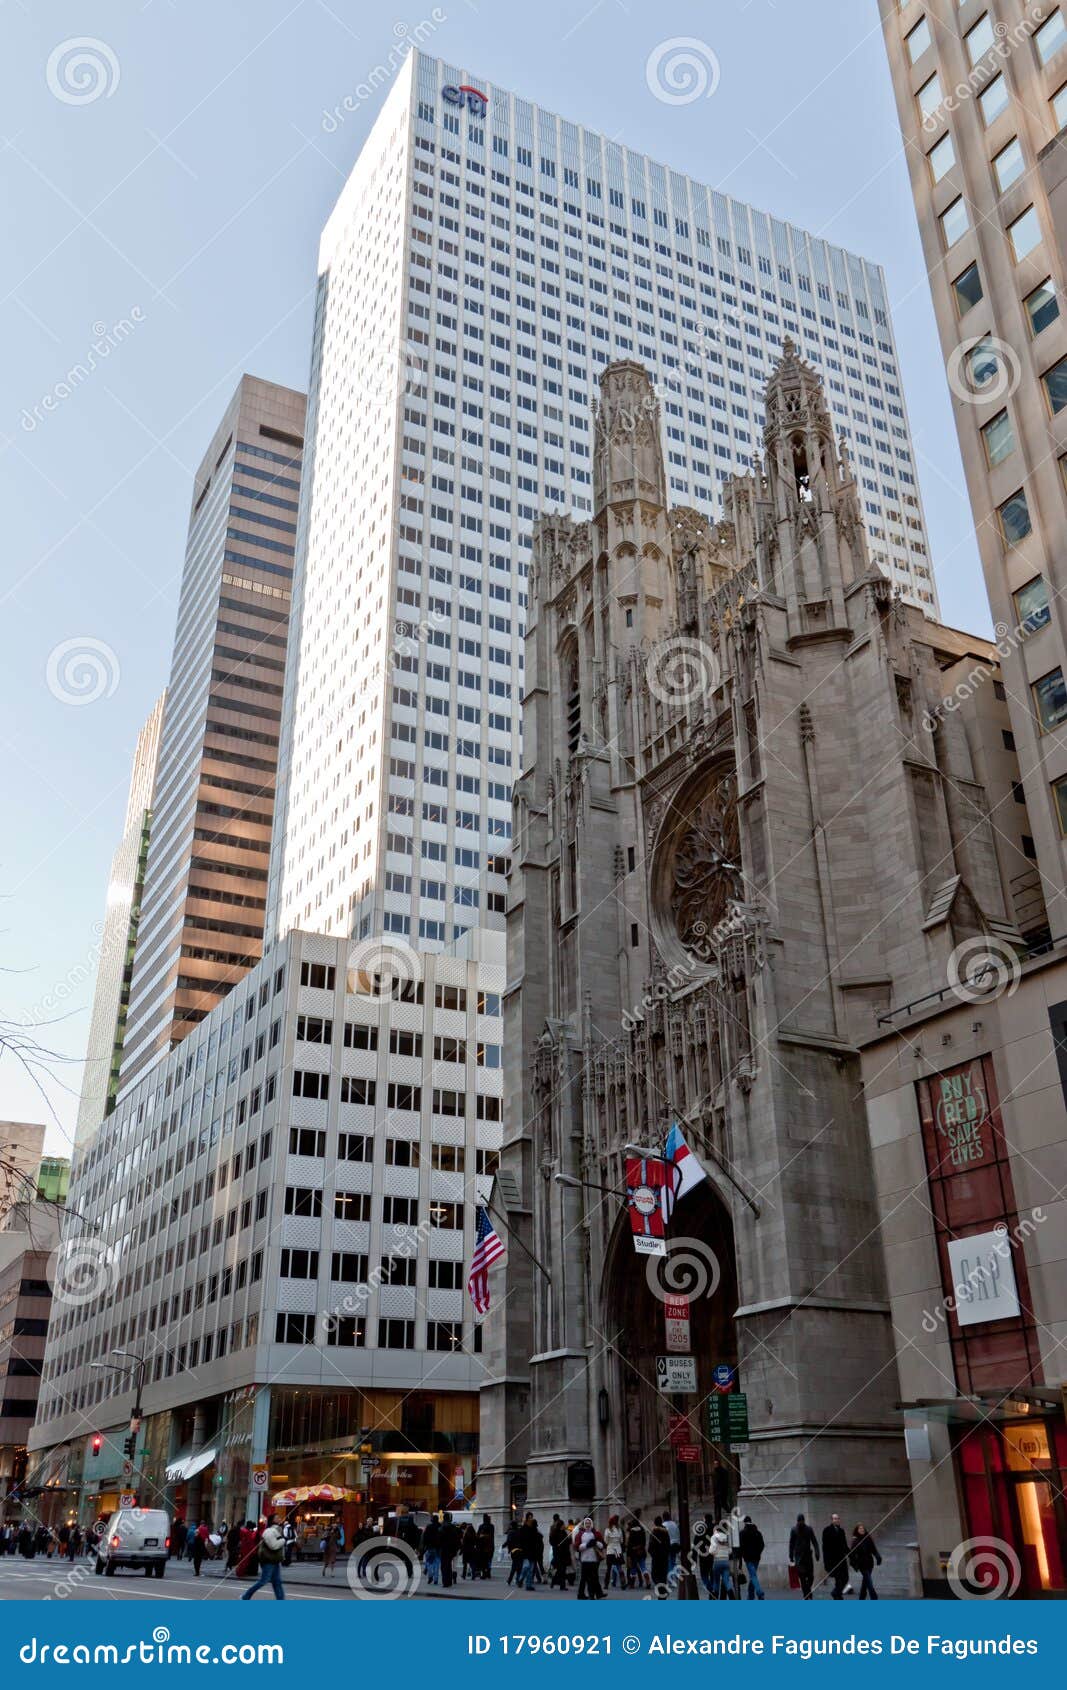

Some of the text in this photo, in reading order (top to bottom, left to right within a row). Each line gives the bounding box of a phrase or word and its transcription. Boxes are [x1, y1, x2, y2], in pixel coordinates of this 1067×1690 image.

[442, 85, 488, 119] citi
[941, 1071, 972, 1103] BUY
[948, 1120, 981, 1147] SAVE
[951, 1140, 984, 1166] LIVES
[668, 1307, 687, 1317] ZONE
[669, 1359, 693, 1367] BUSES
[672, 1371, 691, 1379] ONLY
